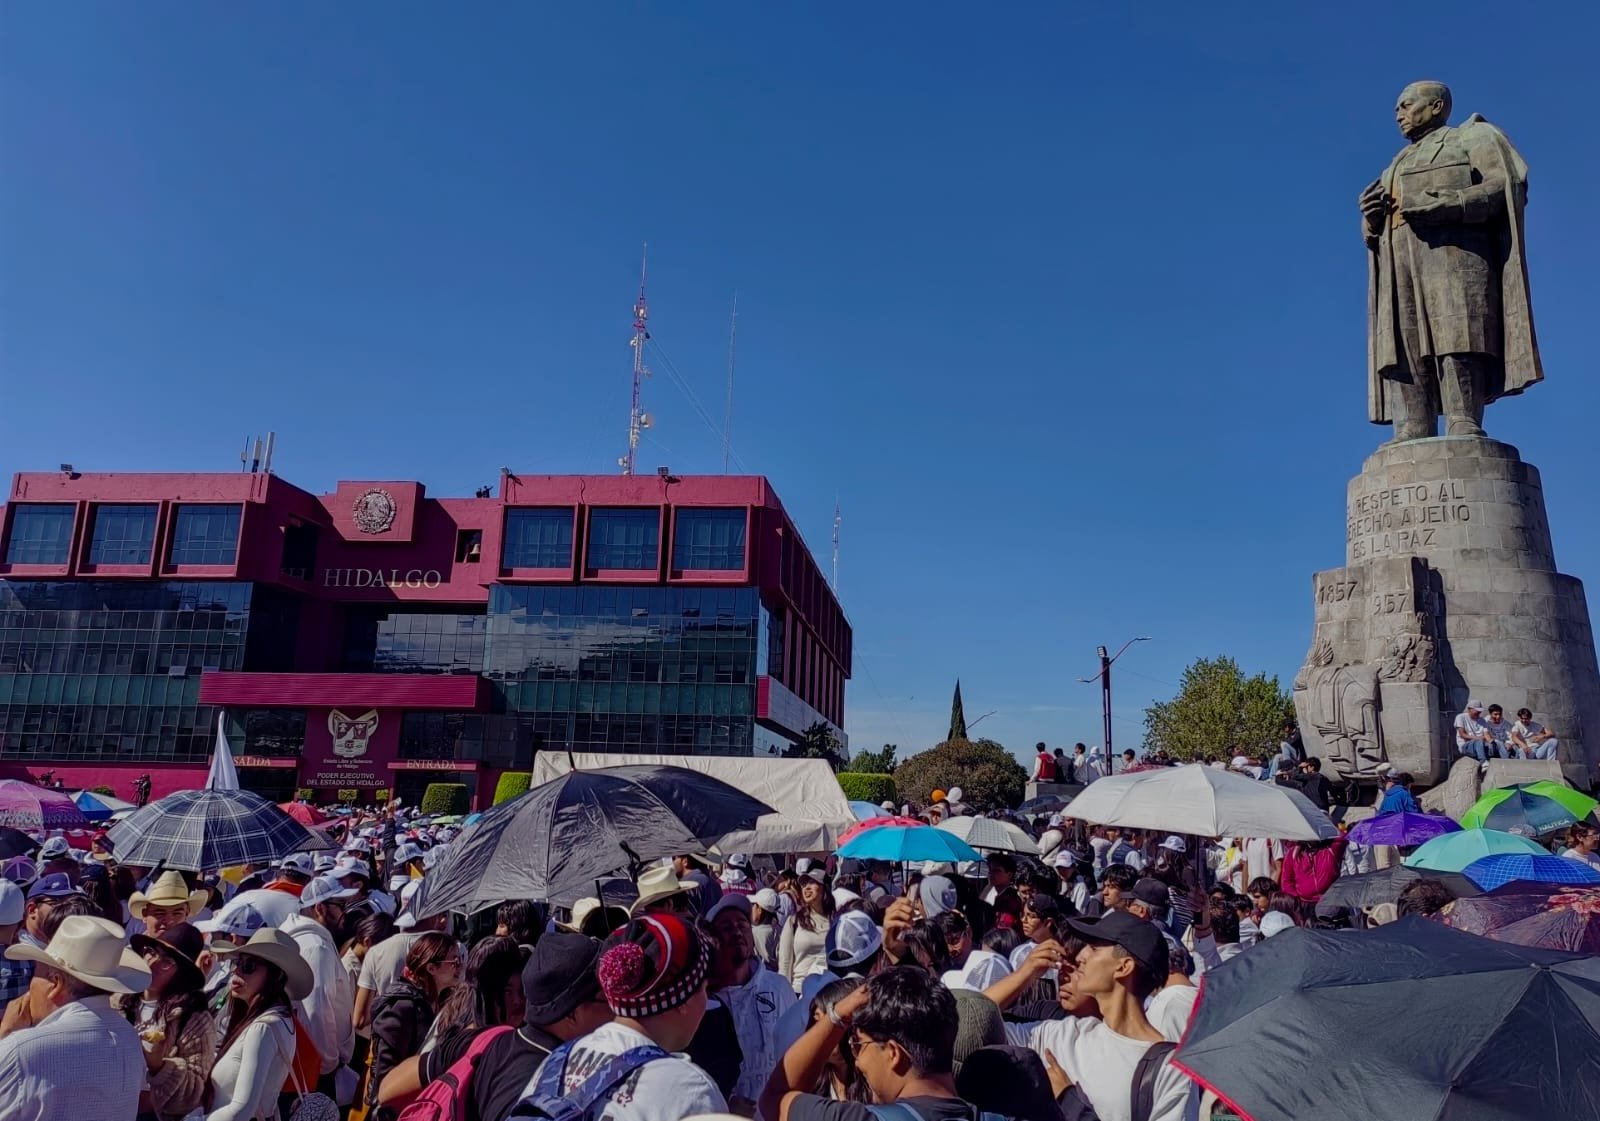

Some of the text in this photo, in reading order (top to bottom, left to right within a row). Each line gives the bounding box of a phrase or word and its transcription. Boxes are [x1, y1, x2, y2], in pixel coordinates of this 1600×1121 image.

[1356, 485, 1428, 514] RESPETO
[1438, 482, 1465, 501] AL
[1400, 504, 1470, 527] AJENO
[1353, 528, 1437, 559] ES LA PAZ
[323, 568, 442, 588] HIDALGO
[1319, 581, 1358, 605] 1857
[233, 756, 272, 767] SALIDA
[406, 760, 457, 769] ENTRADA
